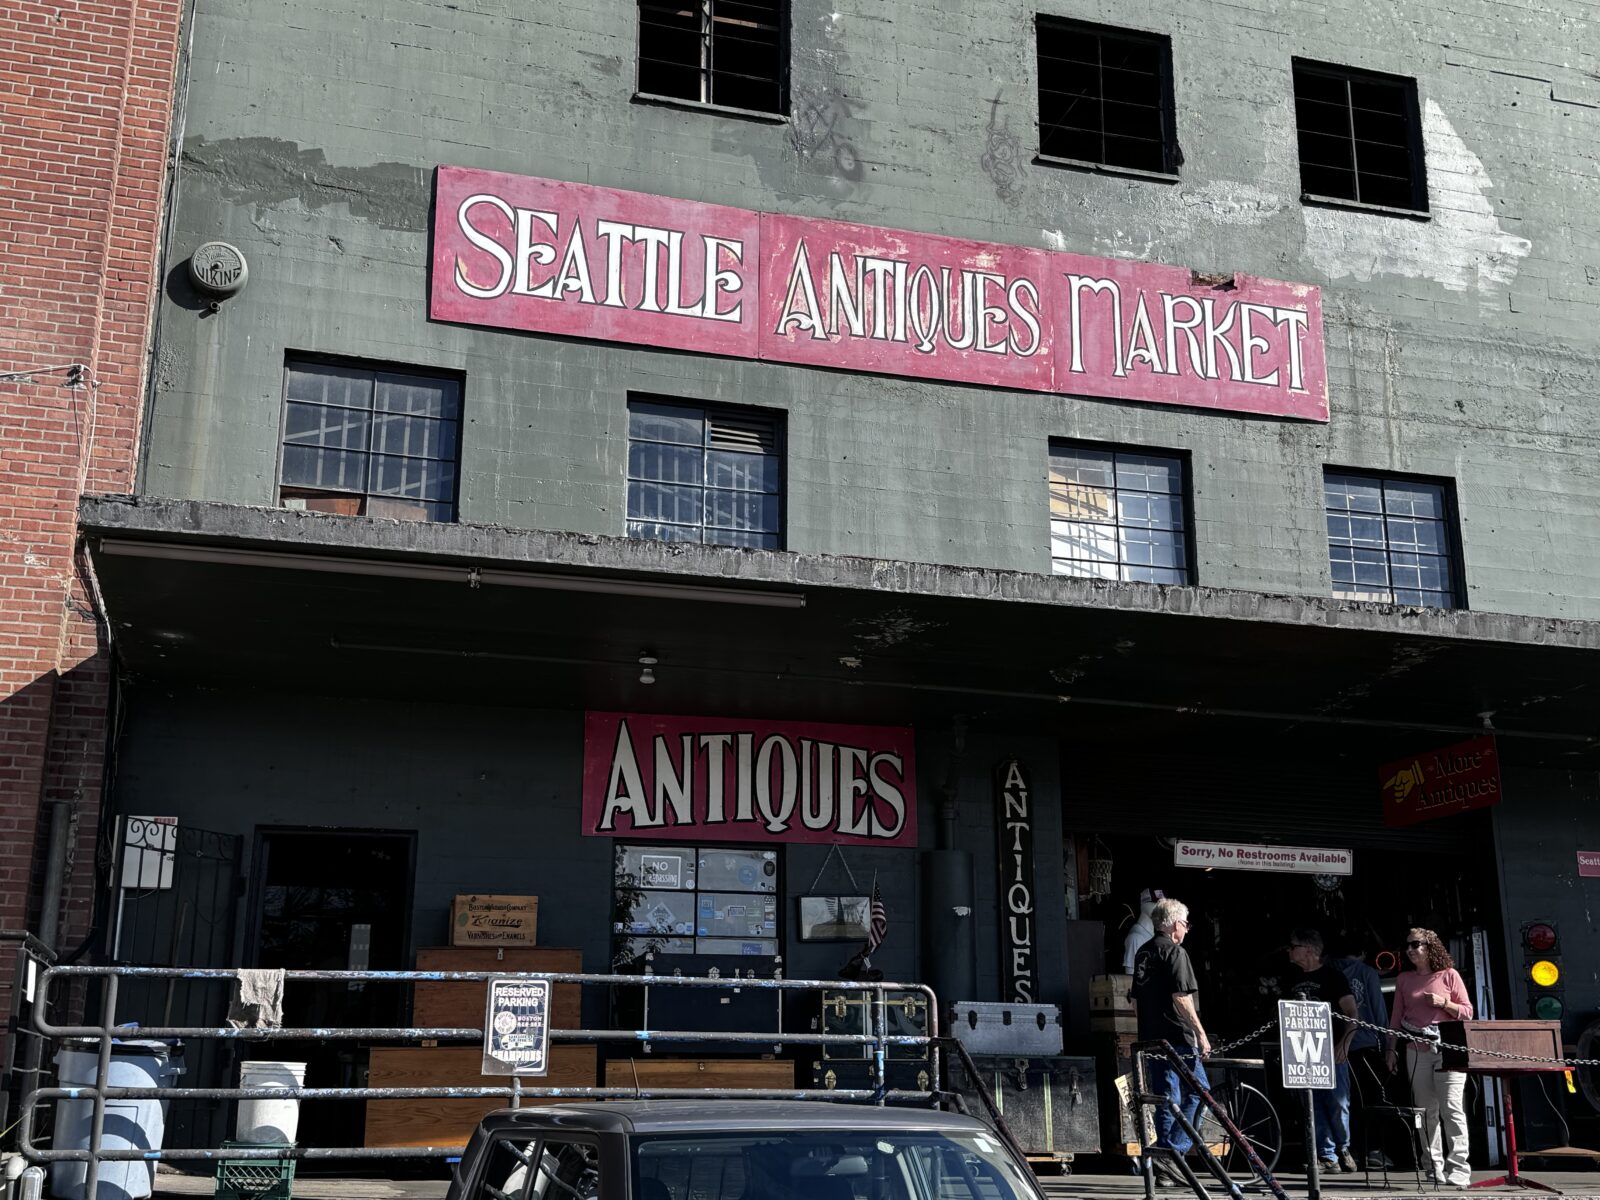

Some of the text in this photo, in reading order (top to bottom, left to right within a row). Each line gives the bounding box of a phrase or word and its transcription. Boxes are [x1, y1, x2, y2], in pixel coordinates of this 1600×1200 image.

[195, 264, 242, 286] VIKING
[454, 193, 1309, 391] SEATTLE ANTIQUES MARKET
[1434, 752, 1482, 779] More
[595, 717, 907, 839] ANTIQUES
[1416, 777, 1497, 811] Antiques
[1181, 845, 1347, 864] Sorry, No Restrooms Available
[652, 861, 668, 871] NO
[1272, 861, 1296, 869] building)
[1003, 761, 1034, 1004] ANTIQUES
[495, 987, 544, 997] RESERVED
[498, 997, 539, 1007] PARKING
[1289, 1005, 1321, 1018] HUSKY
[1285, 1017, 1327, 1030] PARKING
[1286, 1030, 1328, 1063] W
[491, 1050, 543, 1062] CHAMPIONS
[1287, 1063, 1330, 1077] NO NO
[1288, 1076, 1330, 1085] DUCKS COUGS
